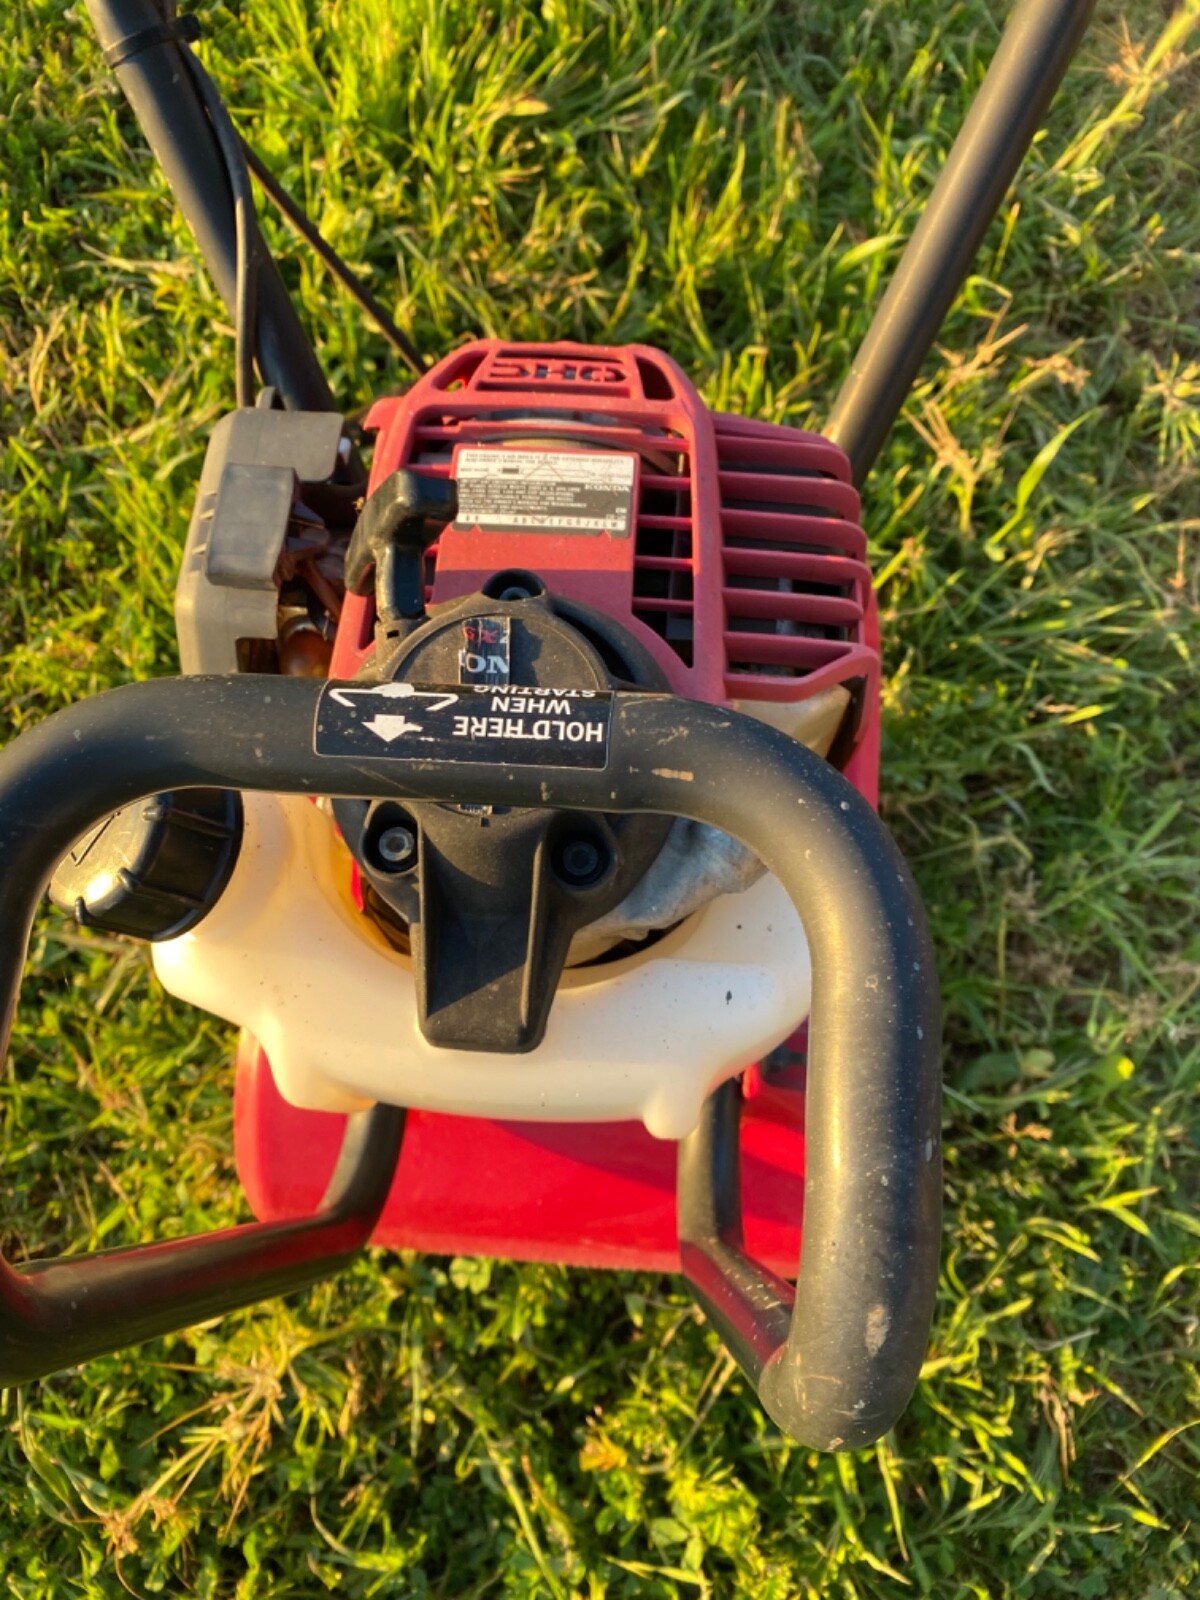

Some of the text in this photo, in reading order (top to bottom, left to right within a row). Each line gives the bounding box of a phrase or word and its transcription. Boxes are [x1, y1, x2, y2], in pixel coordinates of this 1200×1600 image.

[472, 684, 596, 698] STARTING
[491, 696, 572, 715] WHEN
[453, 715, 604, 743] HOLD HERE
